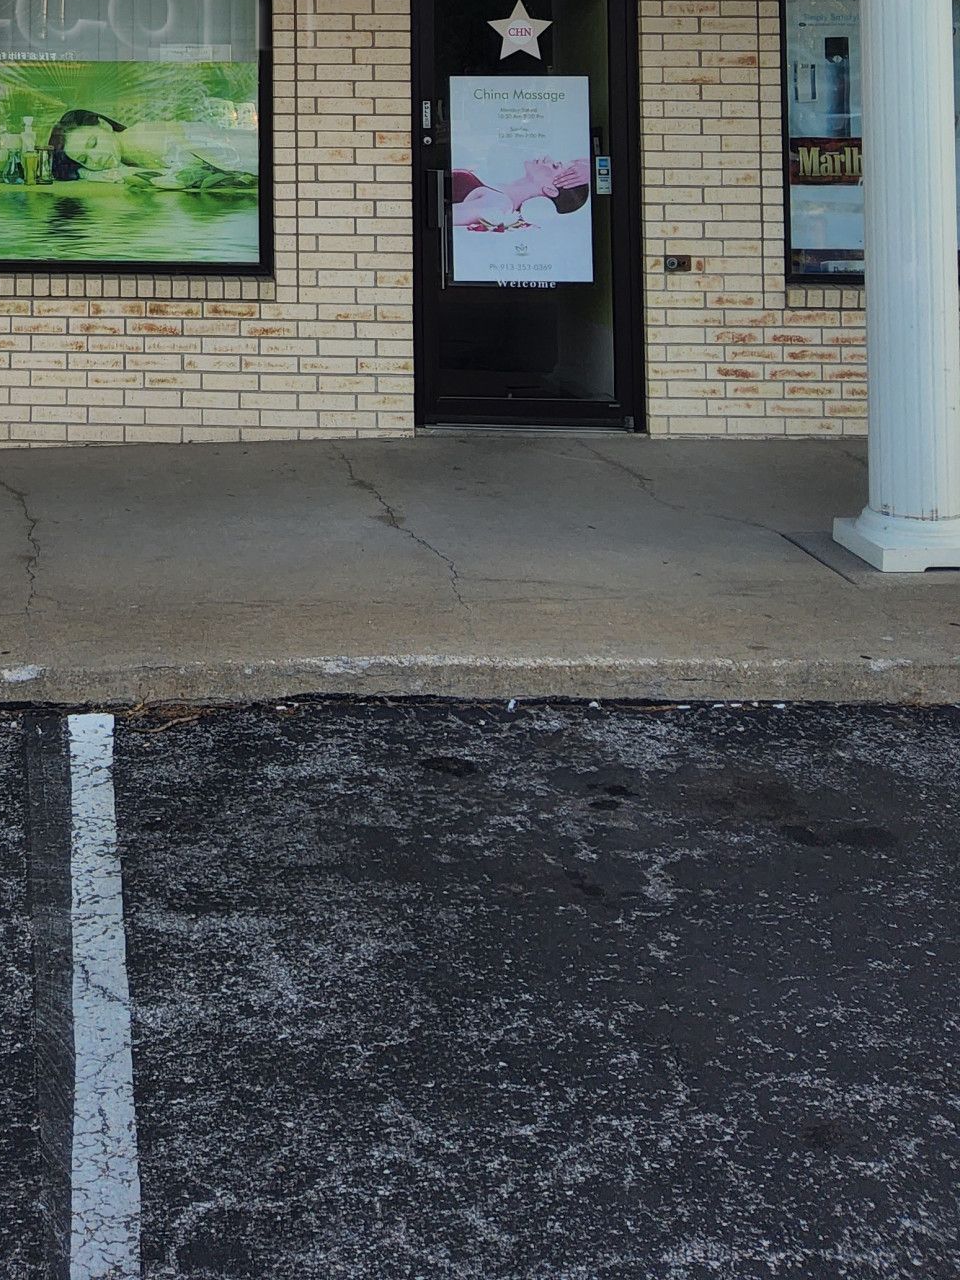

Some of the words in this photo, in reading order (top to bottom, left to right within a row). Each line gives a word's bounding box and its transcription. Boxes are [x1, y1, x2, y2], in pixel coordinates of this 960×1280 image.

[508, 26, 532, 38] CHN
[473, 88, 509, 100] China
[513, 89, 565, 102] Massage
[497, 278, 558, 290] Welcome
